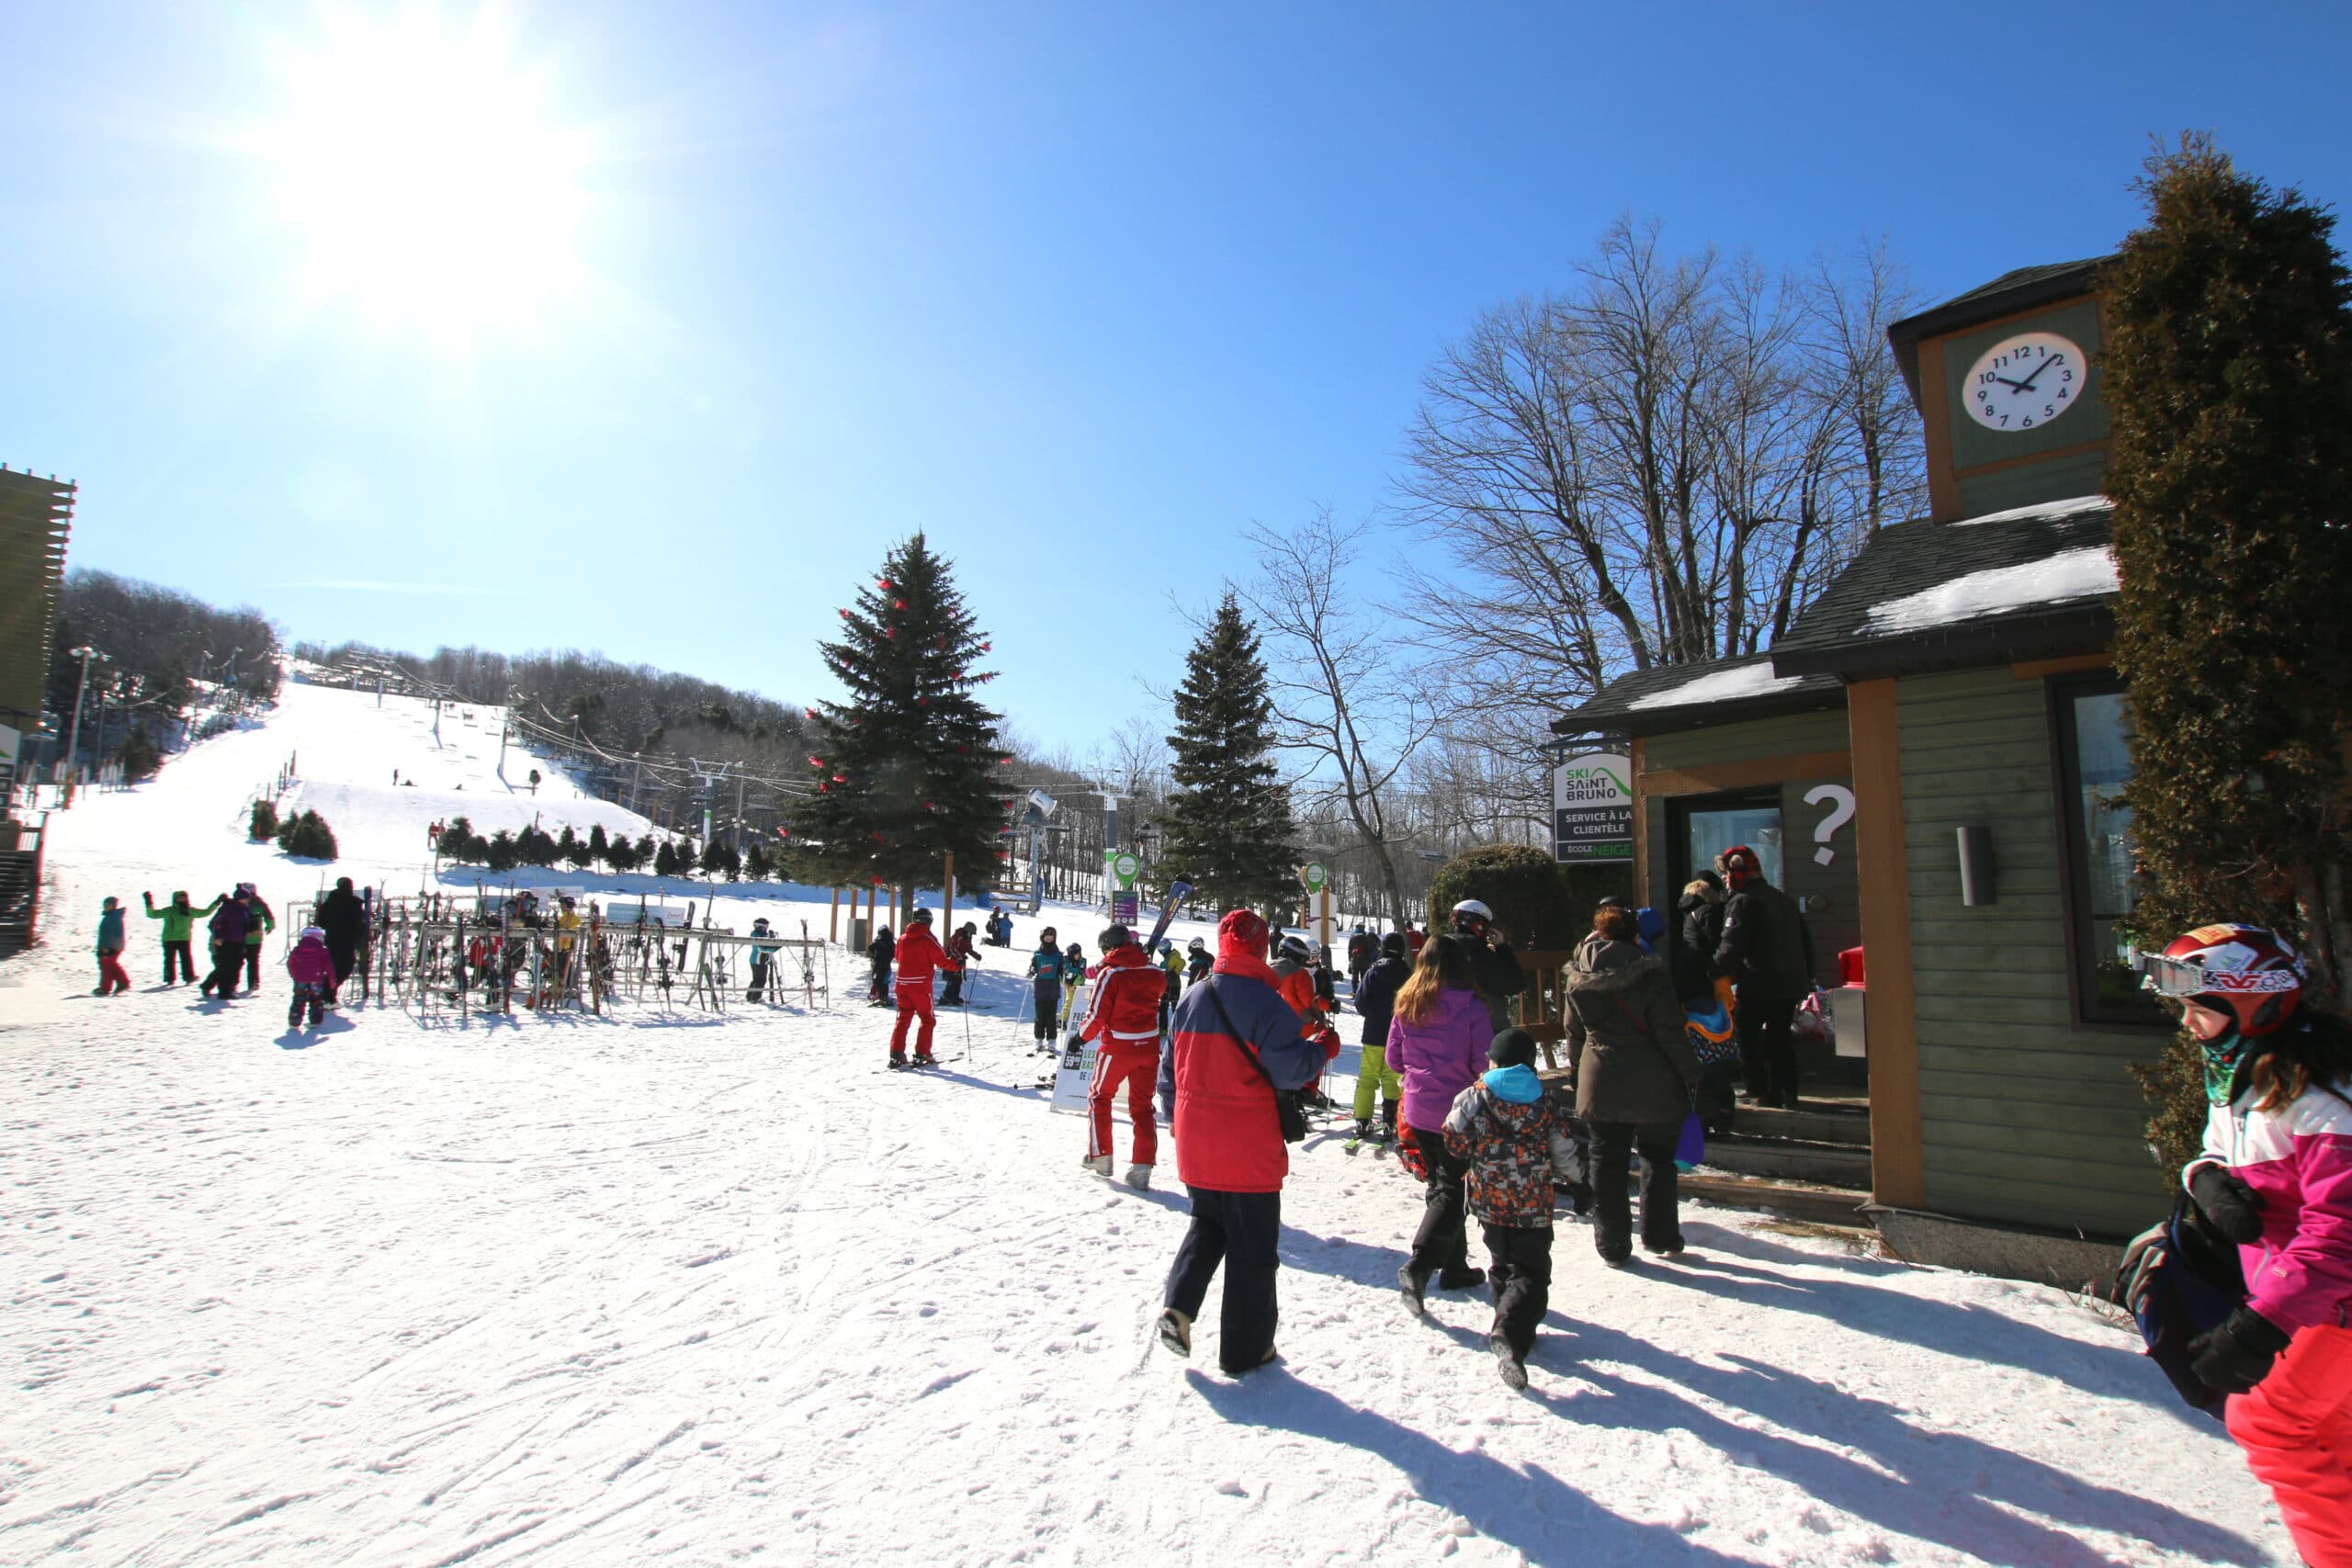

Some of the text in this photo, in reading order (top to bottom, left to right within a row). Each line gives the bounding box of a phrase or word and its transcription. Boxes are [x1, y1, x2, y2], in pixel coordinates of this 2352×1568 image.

[2014, 346, 2030, 359] 12
[2038, 346, 2044, 356] 1
[1994, 356, 2007, 368] 11
[2055, 354, 2064, 366] 2
[1979, 372, 1996, 384] 10
[2063, 370, 2072, 381] 3
[1977, 391, 1987, 401] 9
[2058, 388, 2067, 399] 4
[1985, 405, 1994, 416] 8
[2045, 405, 2053, 416] 5
[2000, 415, 2008, 426] 7
[2022, 416, 2032, 426] 6
[1566, 769, 1589, 779] SKI
[1566, 788, 1616, 800] BRUNO
[1566, 809, 1632, 822] SERVICE À LA
[1573, 823, 1624, 834] CLIENTÈLE
[1803, 784, 1856, 866] ?
[1594, 844, 1632, 855] NEIGE
